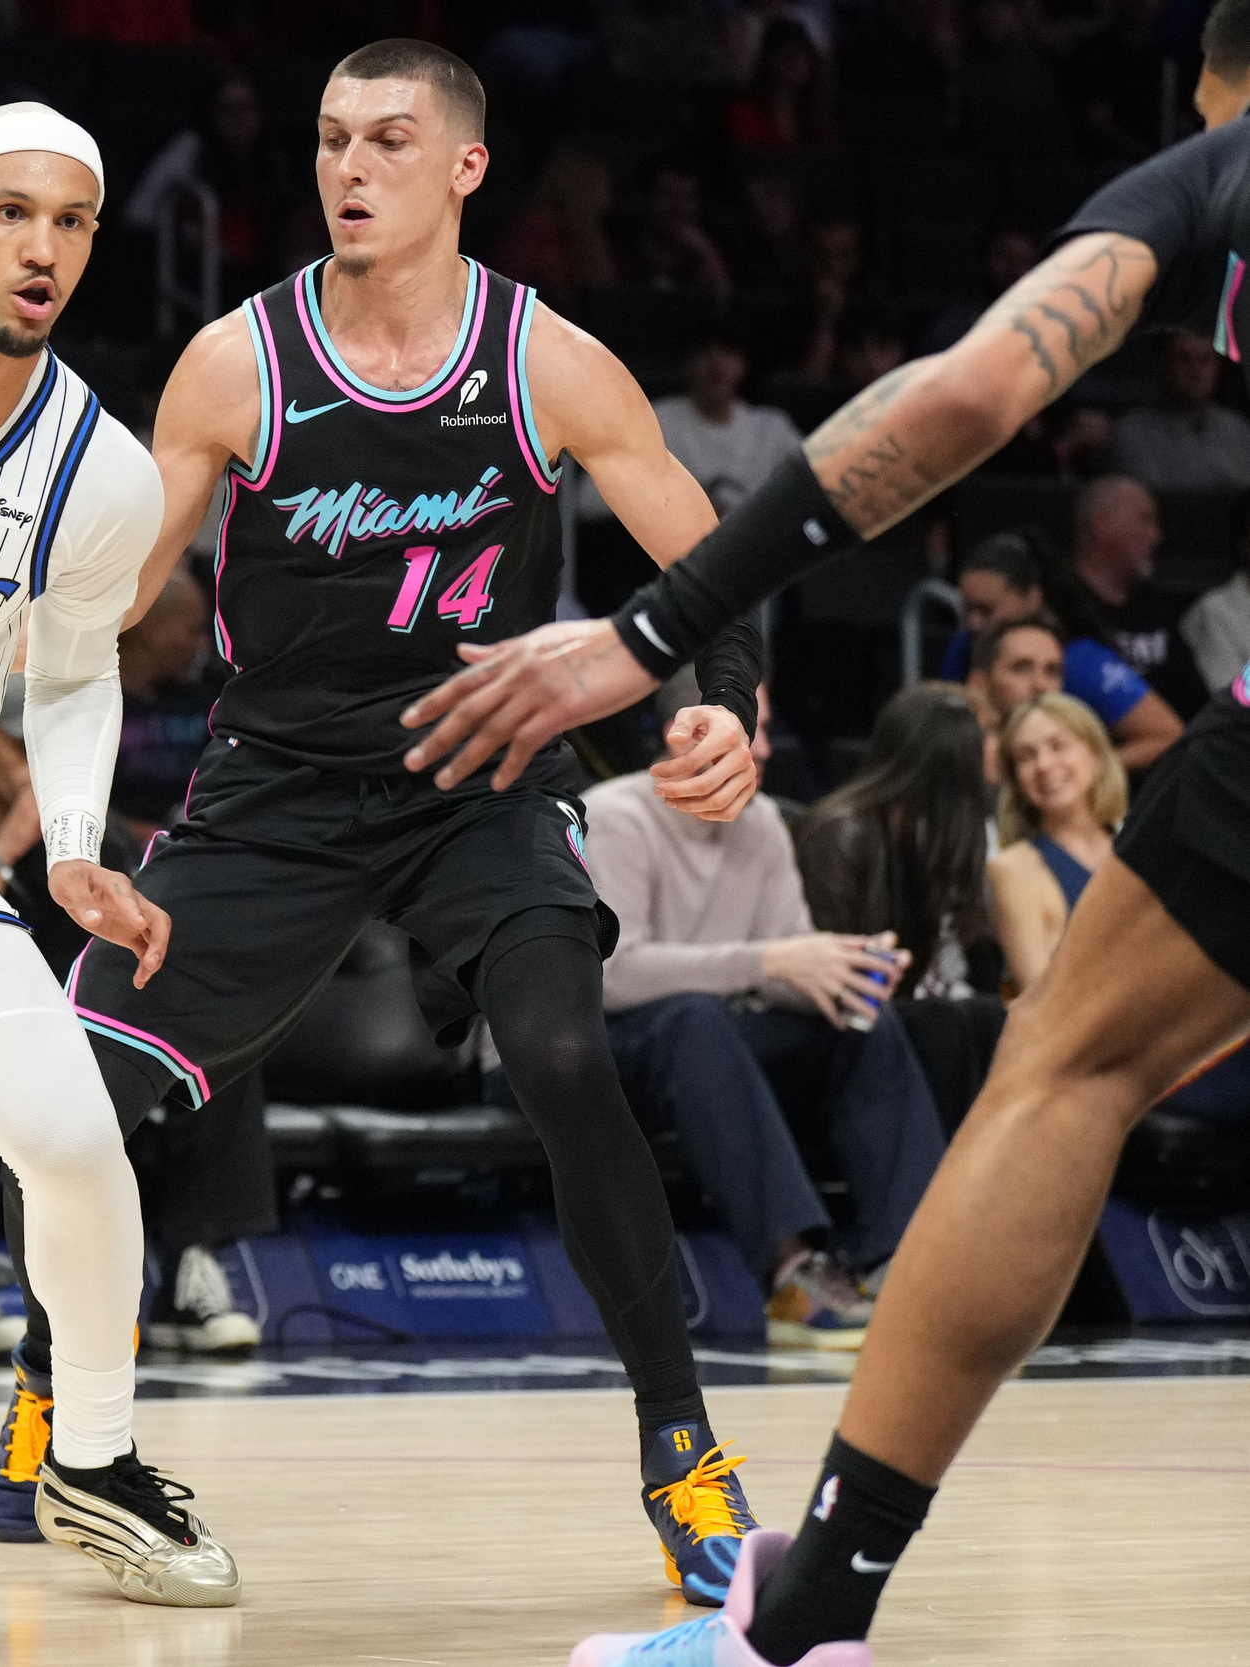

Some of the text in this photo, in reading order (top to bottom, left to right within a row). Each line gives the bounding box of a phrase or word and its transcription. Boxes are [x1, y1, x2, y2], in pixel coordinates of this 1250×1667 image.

[440, 412, 507, 428] Robinhood
[272, 466, 514, 559] Miami
[387, 544, 505, 633] 14
[329, 1251, 525, 1291] ONE Sotheby's
